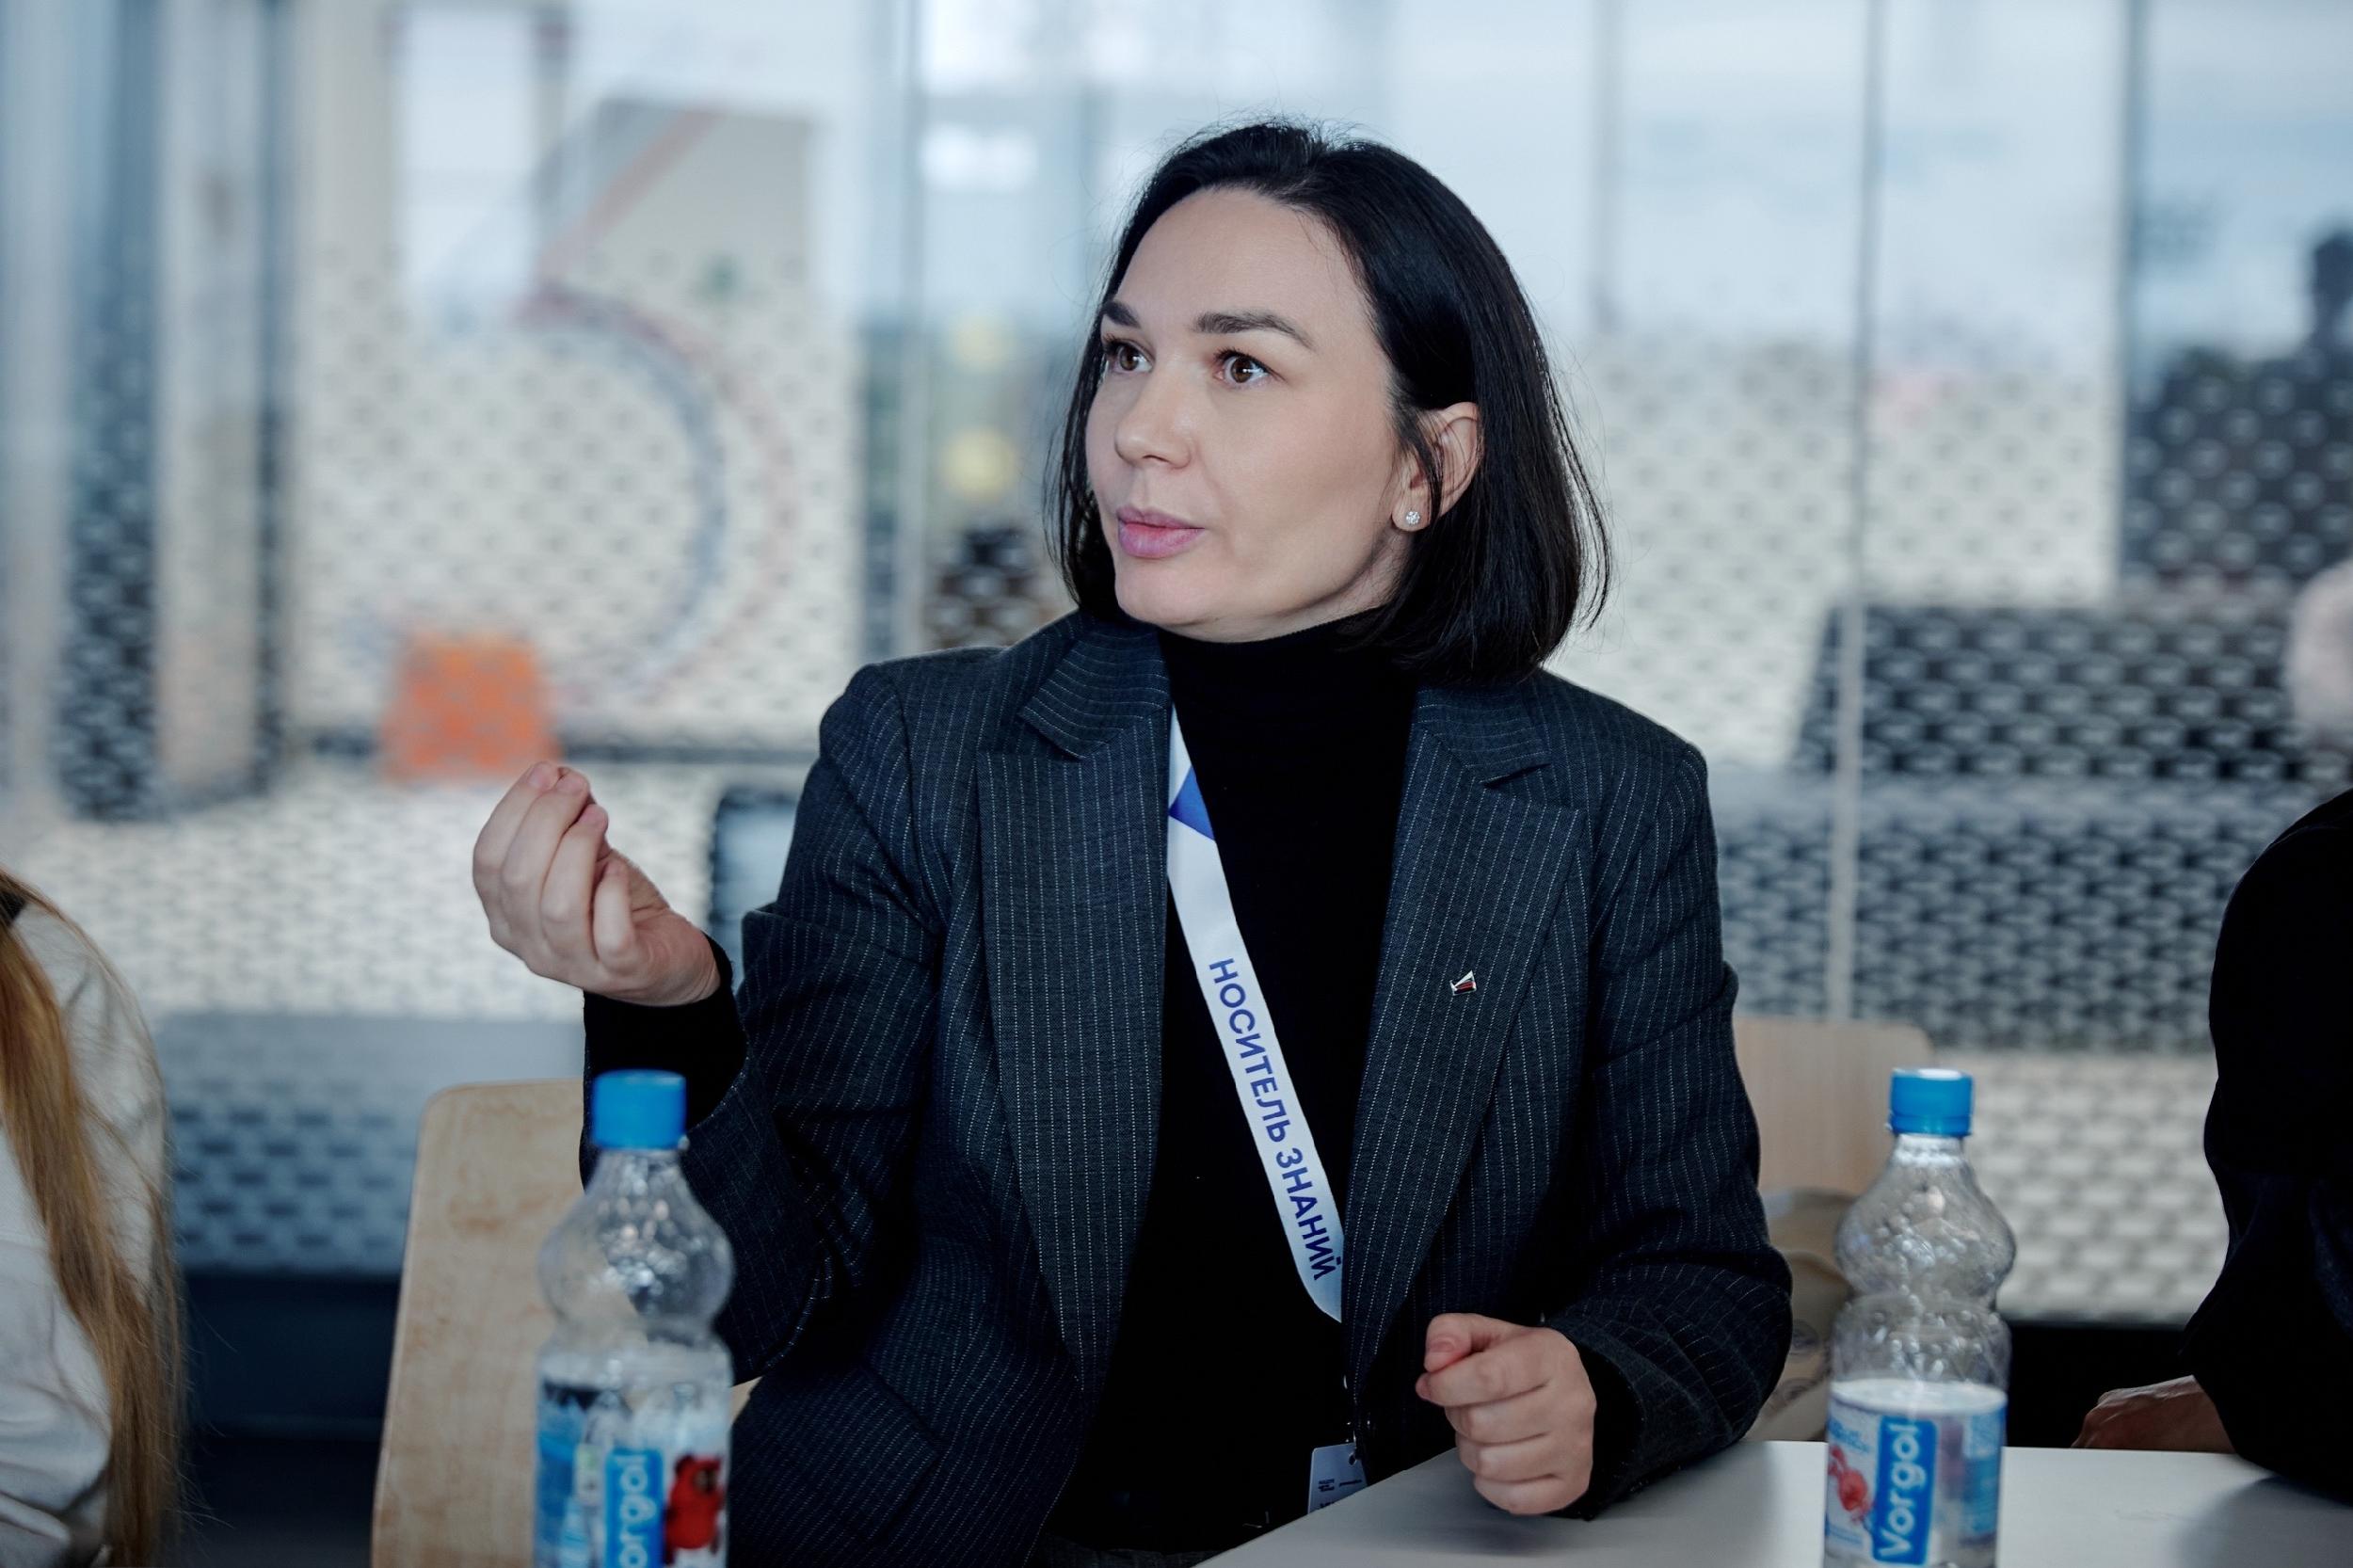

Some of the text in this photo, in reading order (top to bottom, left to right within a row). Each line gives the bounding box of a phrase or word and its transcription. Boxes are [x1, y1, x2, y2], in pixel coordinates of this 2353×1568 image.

[1209, 957, 1342, 1281] НОСИТЕЛЬ ЗНАНИЙ
[613, 1454, 658, 1568] orgol
[1878, 1422, 1927, 1558] Vorgol
